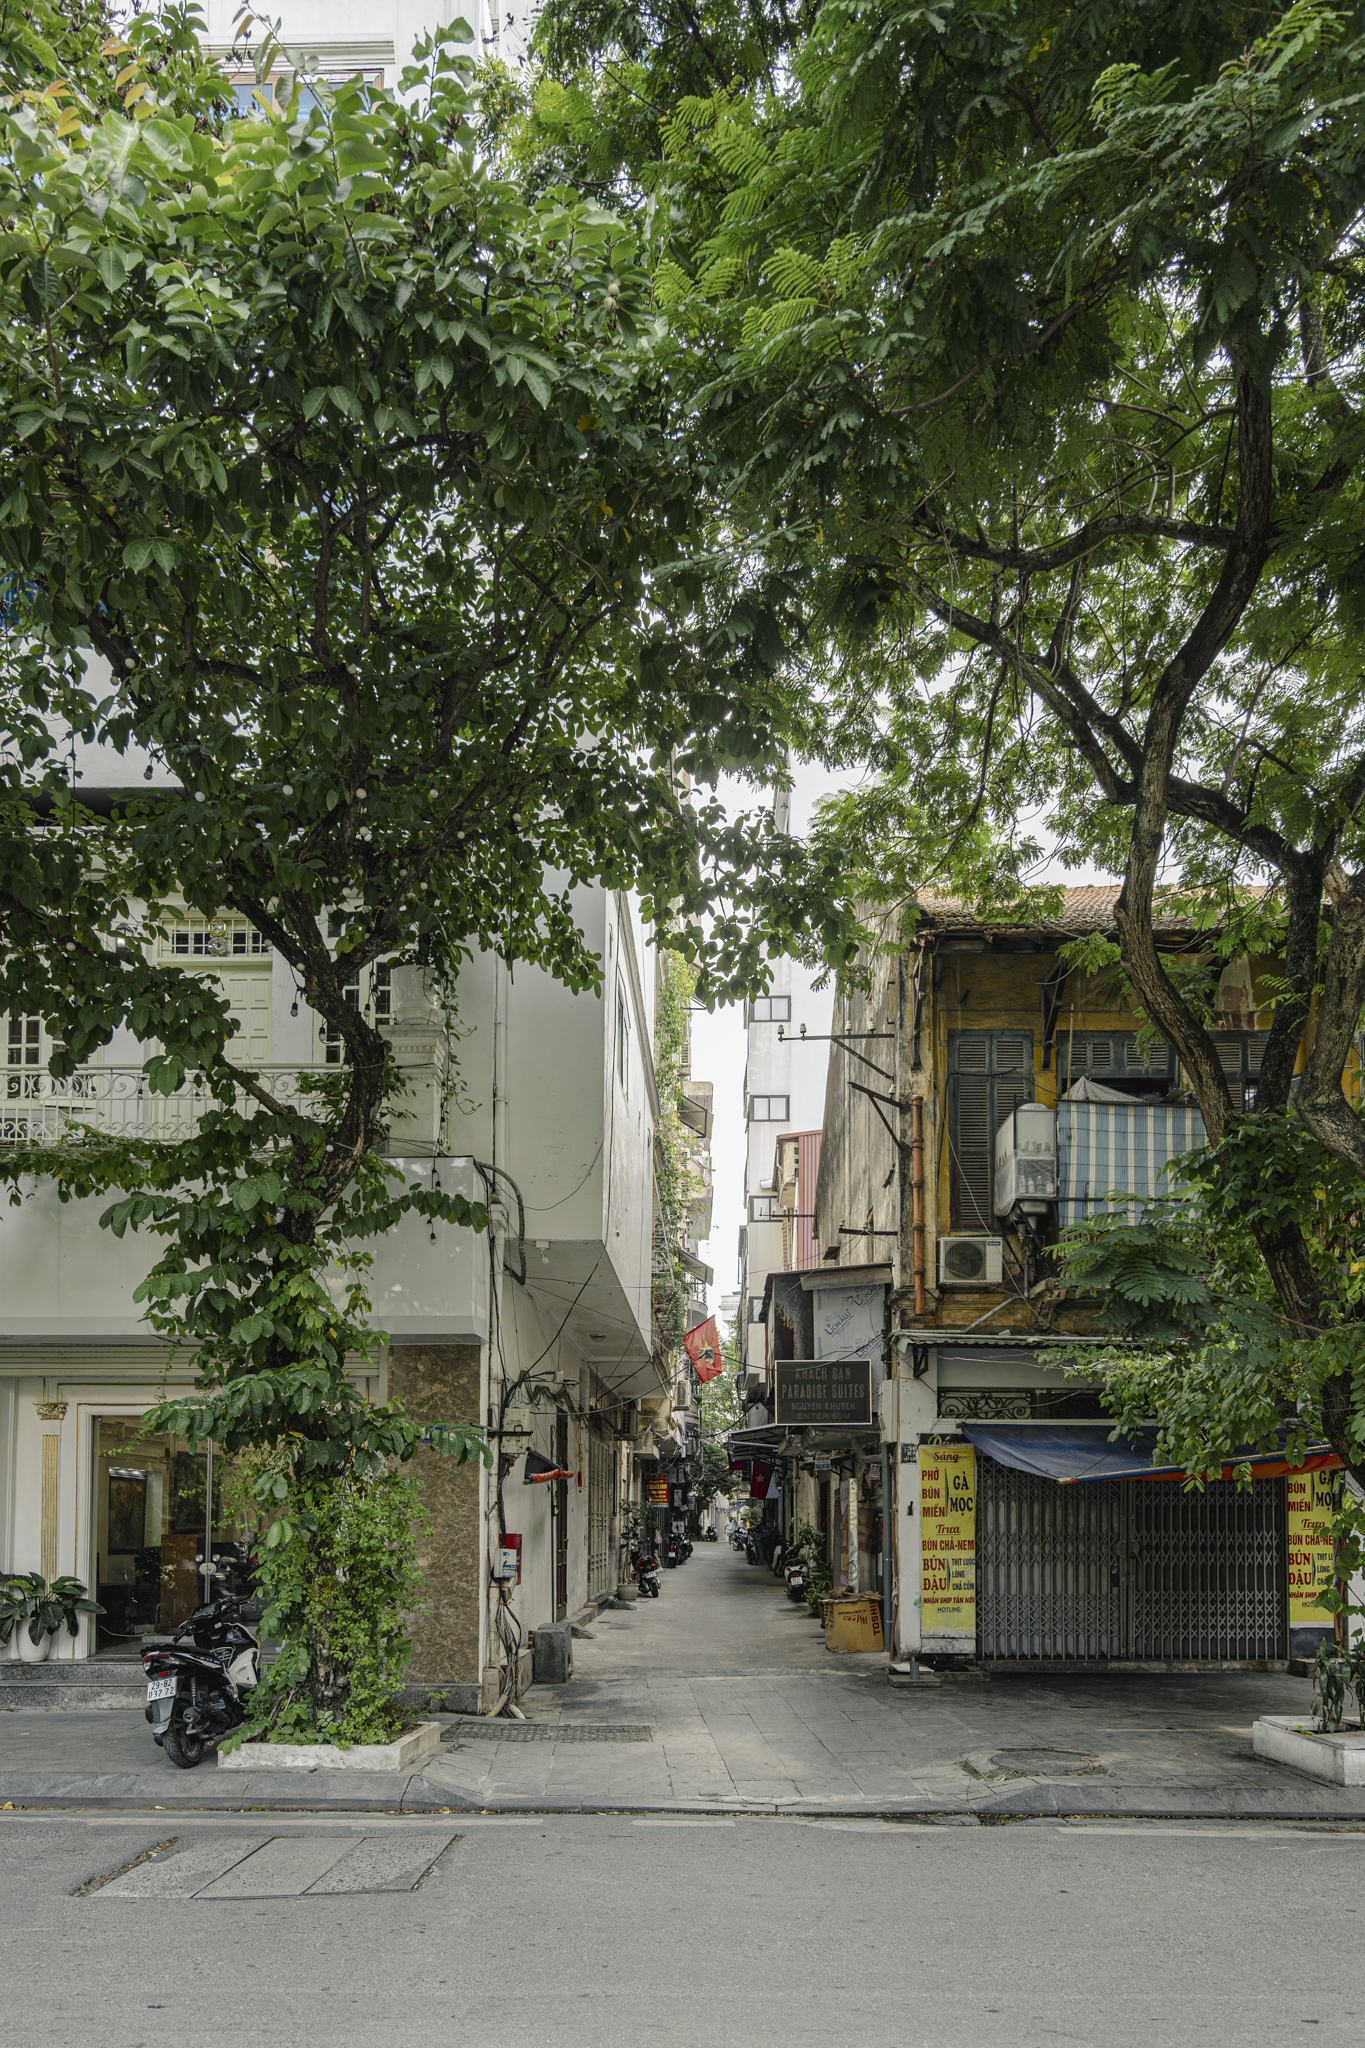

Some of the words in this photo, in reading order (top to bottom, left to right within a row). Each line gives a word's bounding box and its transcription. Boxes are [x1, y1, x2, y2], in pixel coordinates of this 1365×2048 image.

[832, 1367, 851, 1381] SẠN
[782, 1384, 827, 1399] PARADISE
[832, 1384, 865, 1399] SUITES
[797, 1412, 829, 1420] ENTER
[933, 1451, 959, 1463] Sáng
[922, 1466, 940, 1481] PHỞ
[953, 1471, 969, 1490] GÀ
[922, 1486, 940, 1499] BÚN
[1288, 1480, 1306, 1493] BÚN
[950, 1497, 973, 1516] MỌC
[1288, 1498, 1311, 1512] MIẾN
[1316, 1492, 1332, 1511] MỌ
[922, 1503, 945, 1517] MIẾN
[922, 1538, 937, 1551] BÚN
[1288, 1532, 1303, 1545] BÚN
[922, 1555, 946, 1571] BÚN
[1288, 1549, 1311, 1565] BÚN
[923, 1574, 947, 1594] ĐẬU
[1289, 1569, 1312, 1589] ĐẬU
[869, 1600, 881, 1636] TOSHIB
